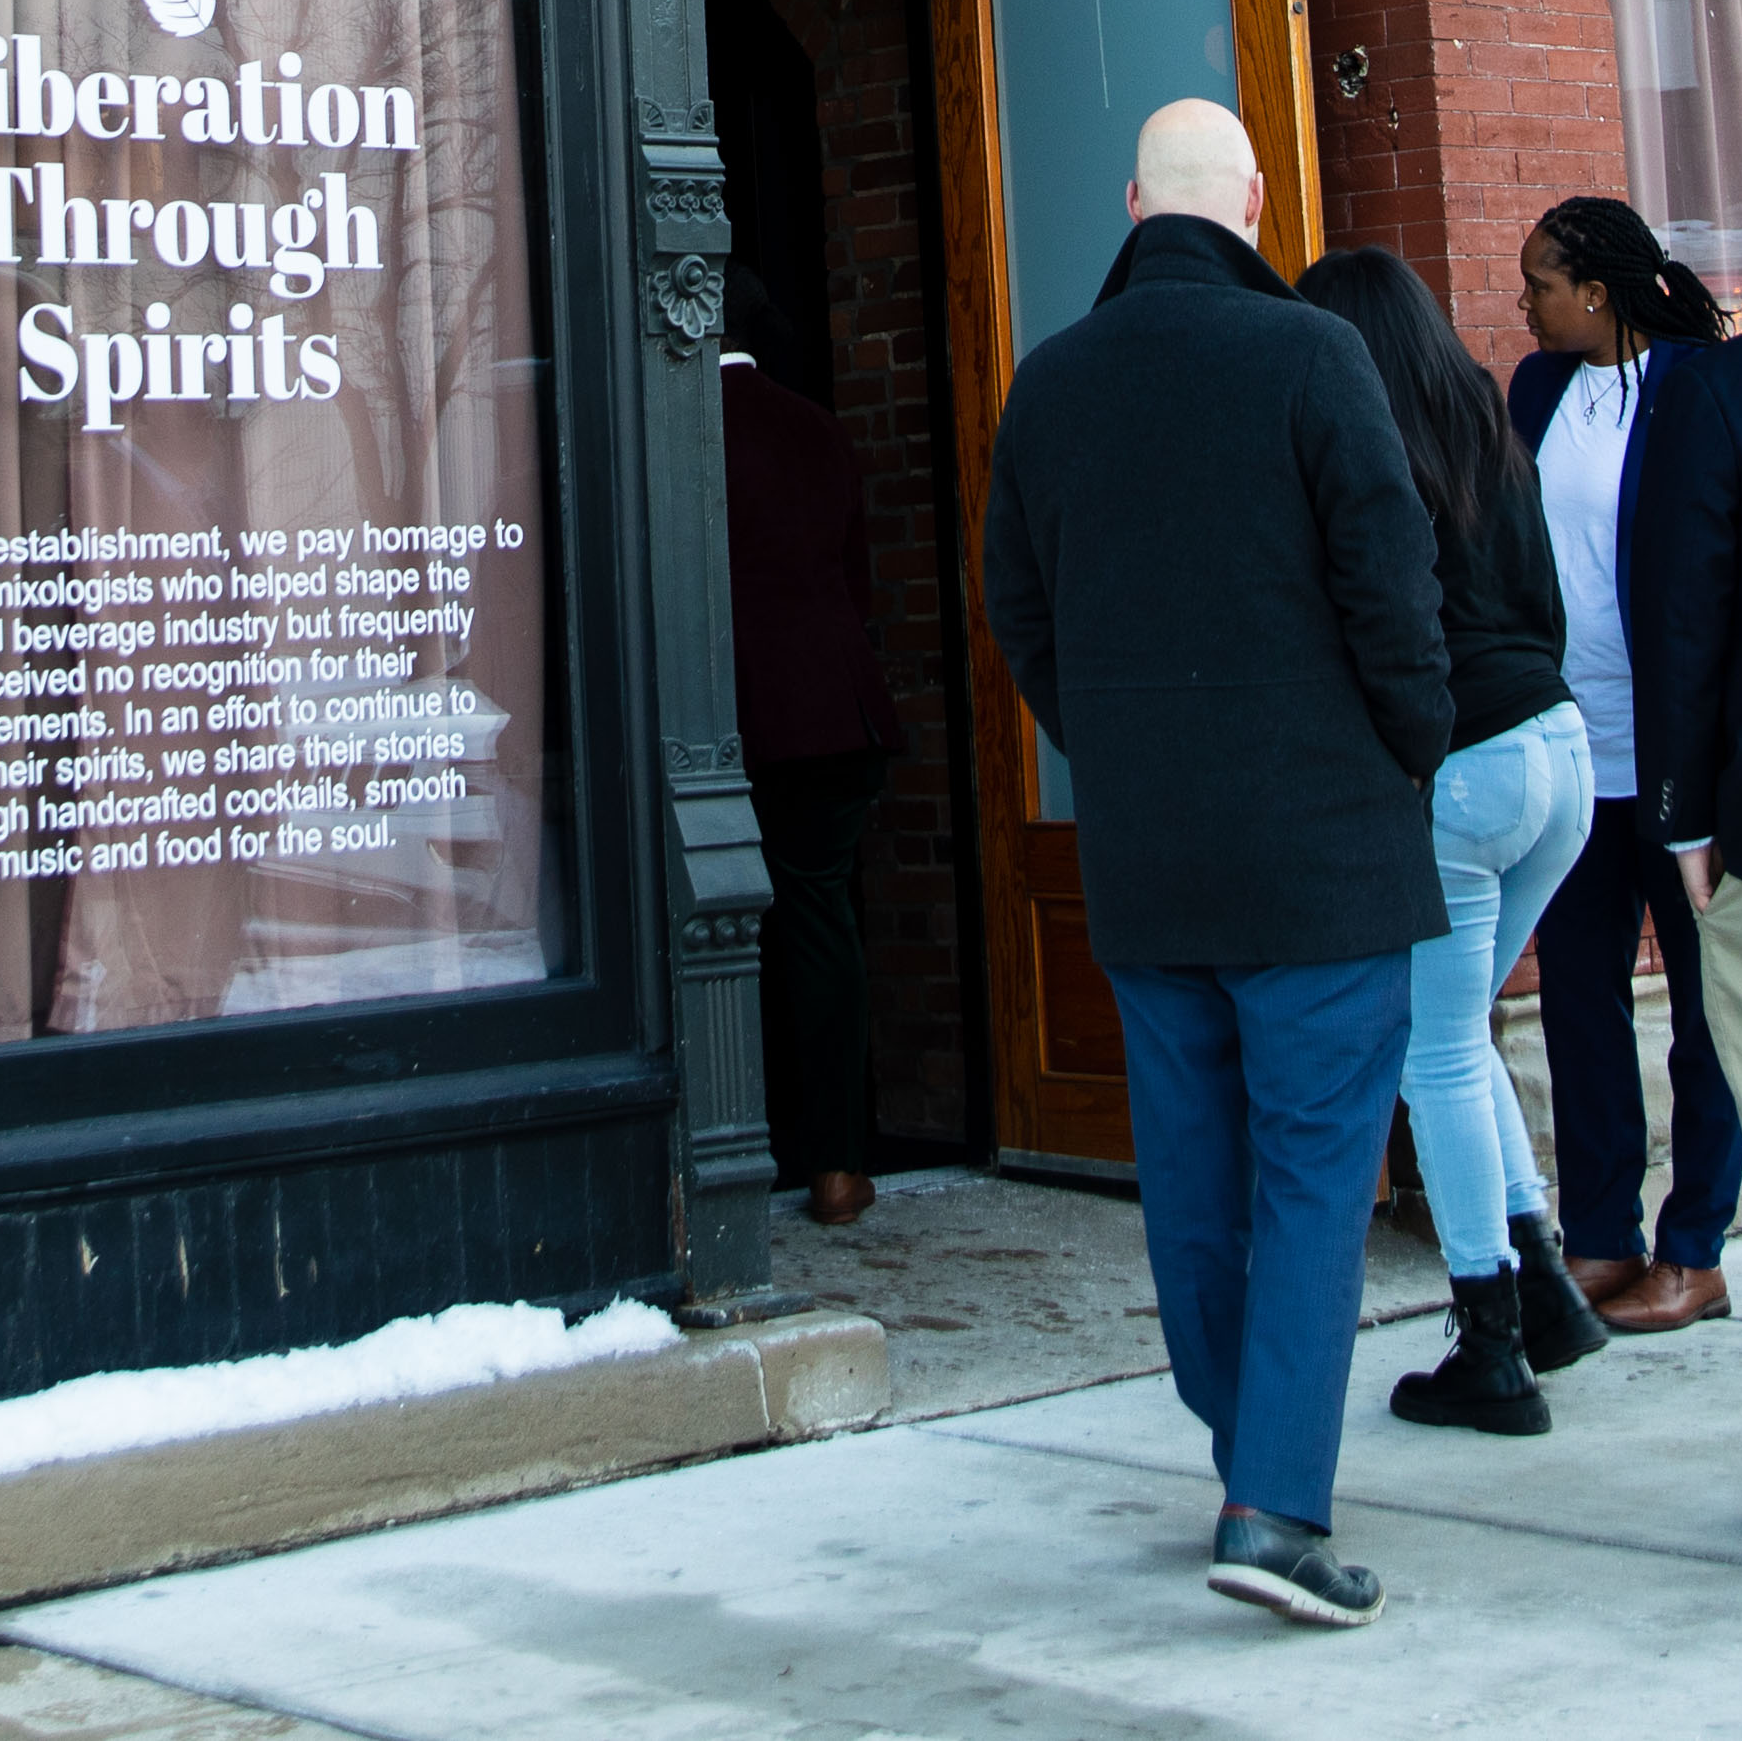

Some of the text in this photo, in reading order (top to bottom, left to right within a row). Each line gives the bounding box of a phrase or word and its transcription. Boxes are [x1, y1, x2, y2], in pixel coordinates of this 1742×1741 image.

[19, 302, 342, 430] Spirits
[241, 529, 287, 556] we
[298, 527, 354, 562] pay
[363, 520, 486, 557] homage
[494, 518, 523, 548] to
[162, 568, 223, 602] who
[231, 564, 326, 604] helped
[335, 563, 420, 599] shape
[427, 560, 470, 592] the
[13, 618, 155, 656] beverage
[163, 611, 279, 649] industry
[287, 607, 331, 641] but
[339, 601, 474, 643] frequently
[96, 664, 134, 693] no
[142, 653, 302, 695] recognition
[310, 648, 348, 682] for
[356, 645, 417, 679] their
[125, 702, 152, 735] In
[161, 705, 198, 734] an
[207, 694, 281, 731] effort
[289, 693, 317, 725] to
[325, 688, 442, 723] continue
[449, 685, 476, 714] to
[55, 746, 153, 791] spirits,
[163, 748, 206, 777] we
[214, 739, 295, 775] share
[304, 733, 366, 767] their
[374, 728, 465, 761] stories
[38, 784, 216, 831] handcrafted
[225, 776, 356, 818] cocktails,
[365, 767, 466, 806] smooth
[90, 833, 147, 872] and
[156, 827, 221, 866] food
[229, 825, 270, 859] for
[277, 823, 322, 857] the
[330, 815, 396, 854] soul.
